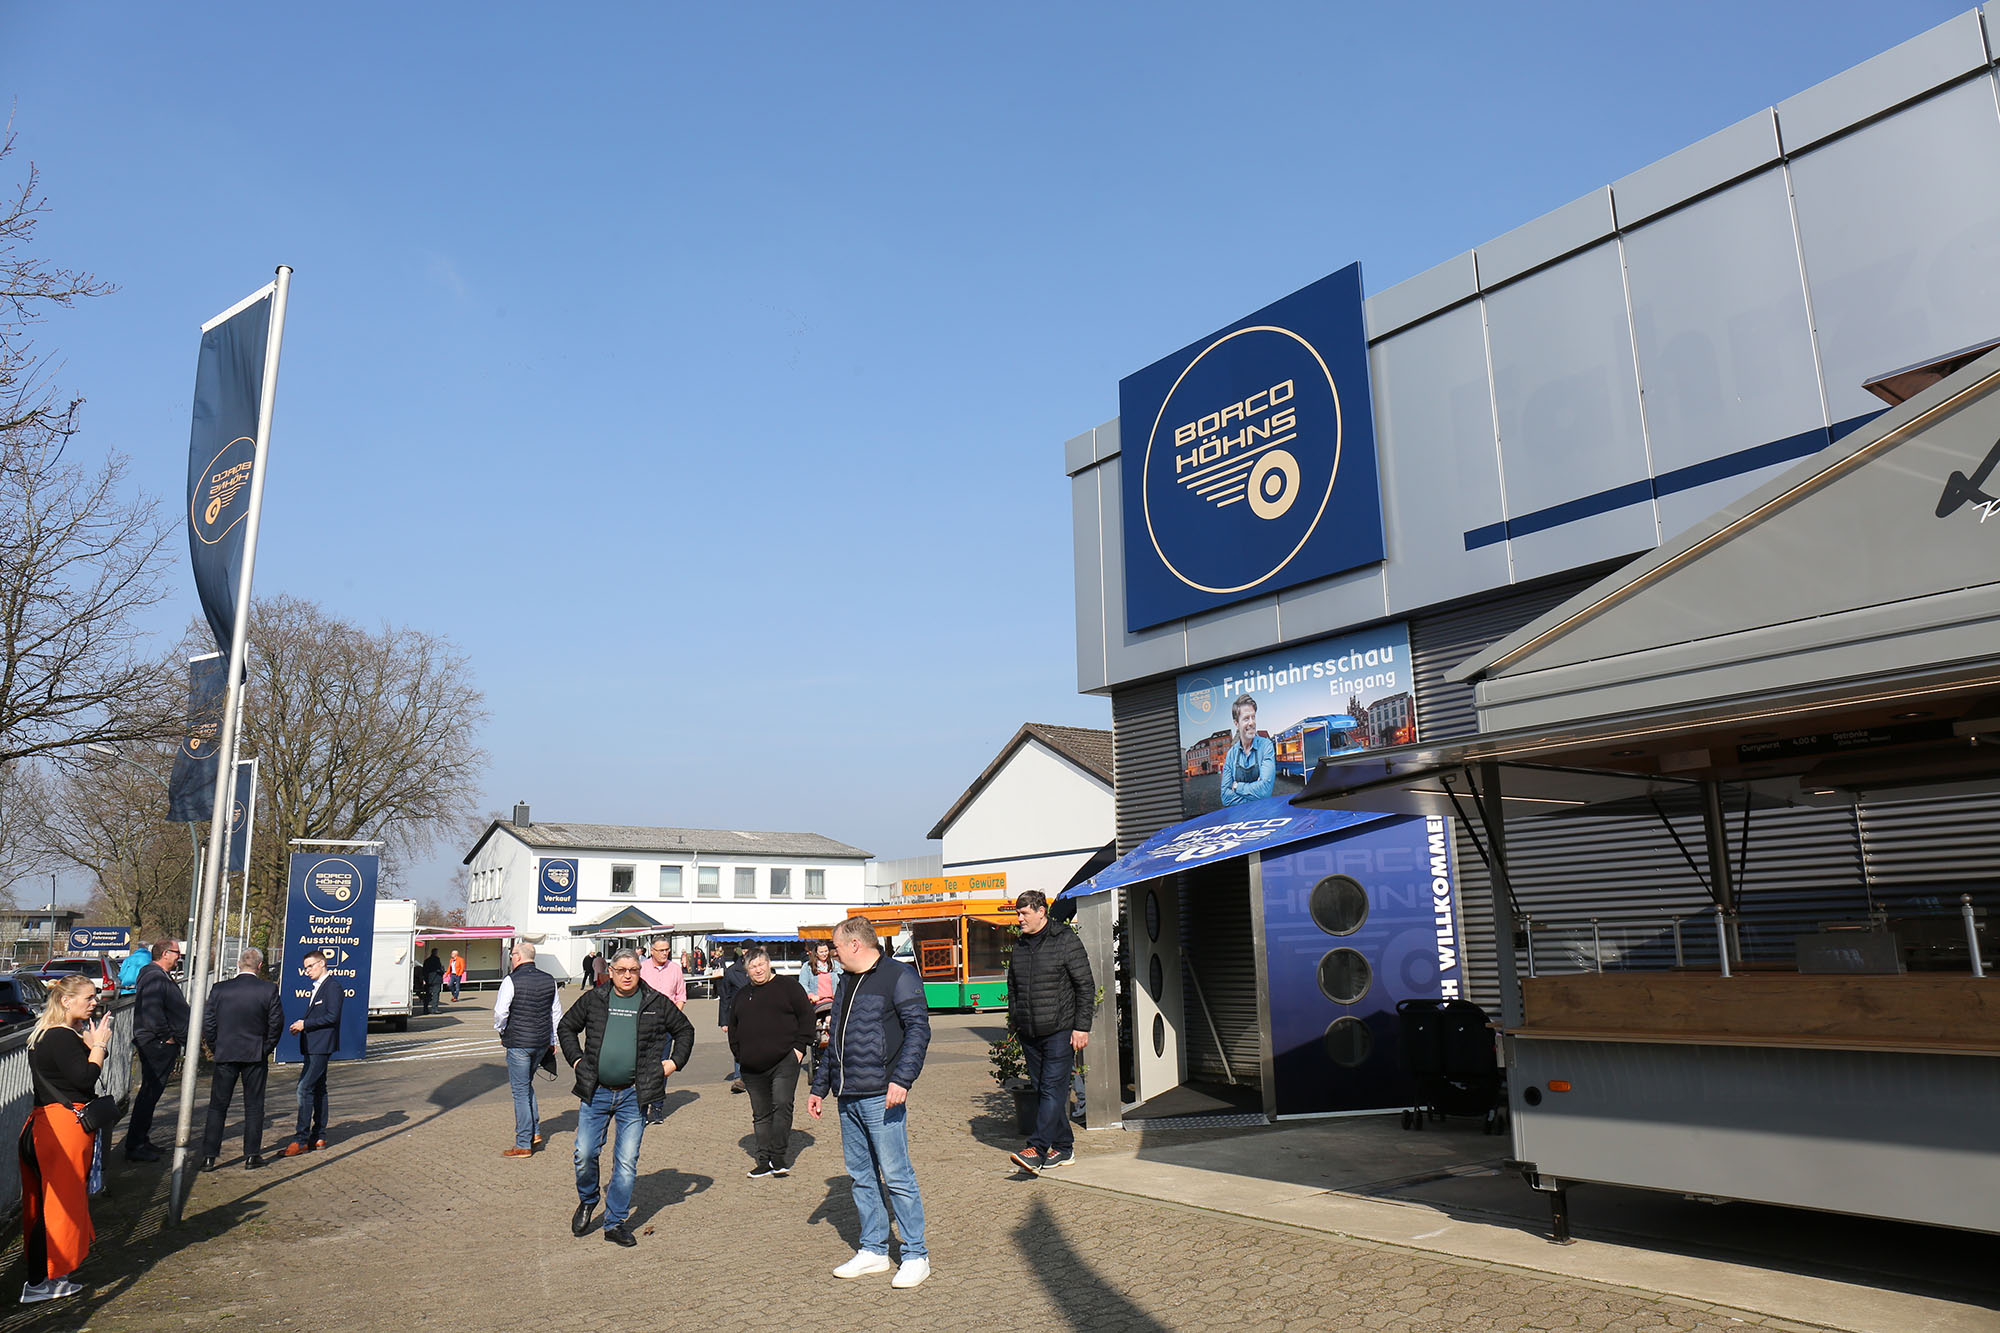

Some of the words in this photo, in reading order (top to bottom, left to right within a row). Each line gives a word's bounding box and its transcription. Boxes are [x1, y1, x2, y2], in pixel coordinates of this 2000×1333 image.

[1174, 379, 1294, 447] BORCO
[1176, 406, 1296, 474] HÖHNS
[1223, 645, 1394, 698] Frühjahrsschau
[1330, 671, 1396, 696] Eingang
[1172, 817, 1293, 842] BORCO
[904, 881, 933, 892] Kräuter
[944, 879, 957, 890] Tee
[969, 876, 1005, 889] Gewürze
[538, 905, 576, 913] Vermietung
[309, 915, 353, 926] Empfang
[310, 925, 351, 934] Verkauf
[299, 935, 360, 946] Ausstellung
[343, 989, 355, 998] 10
